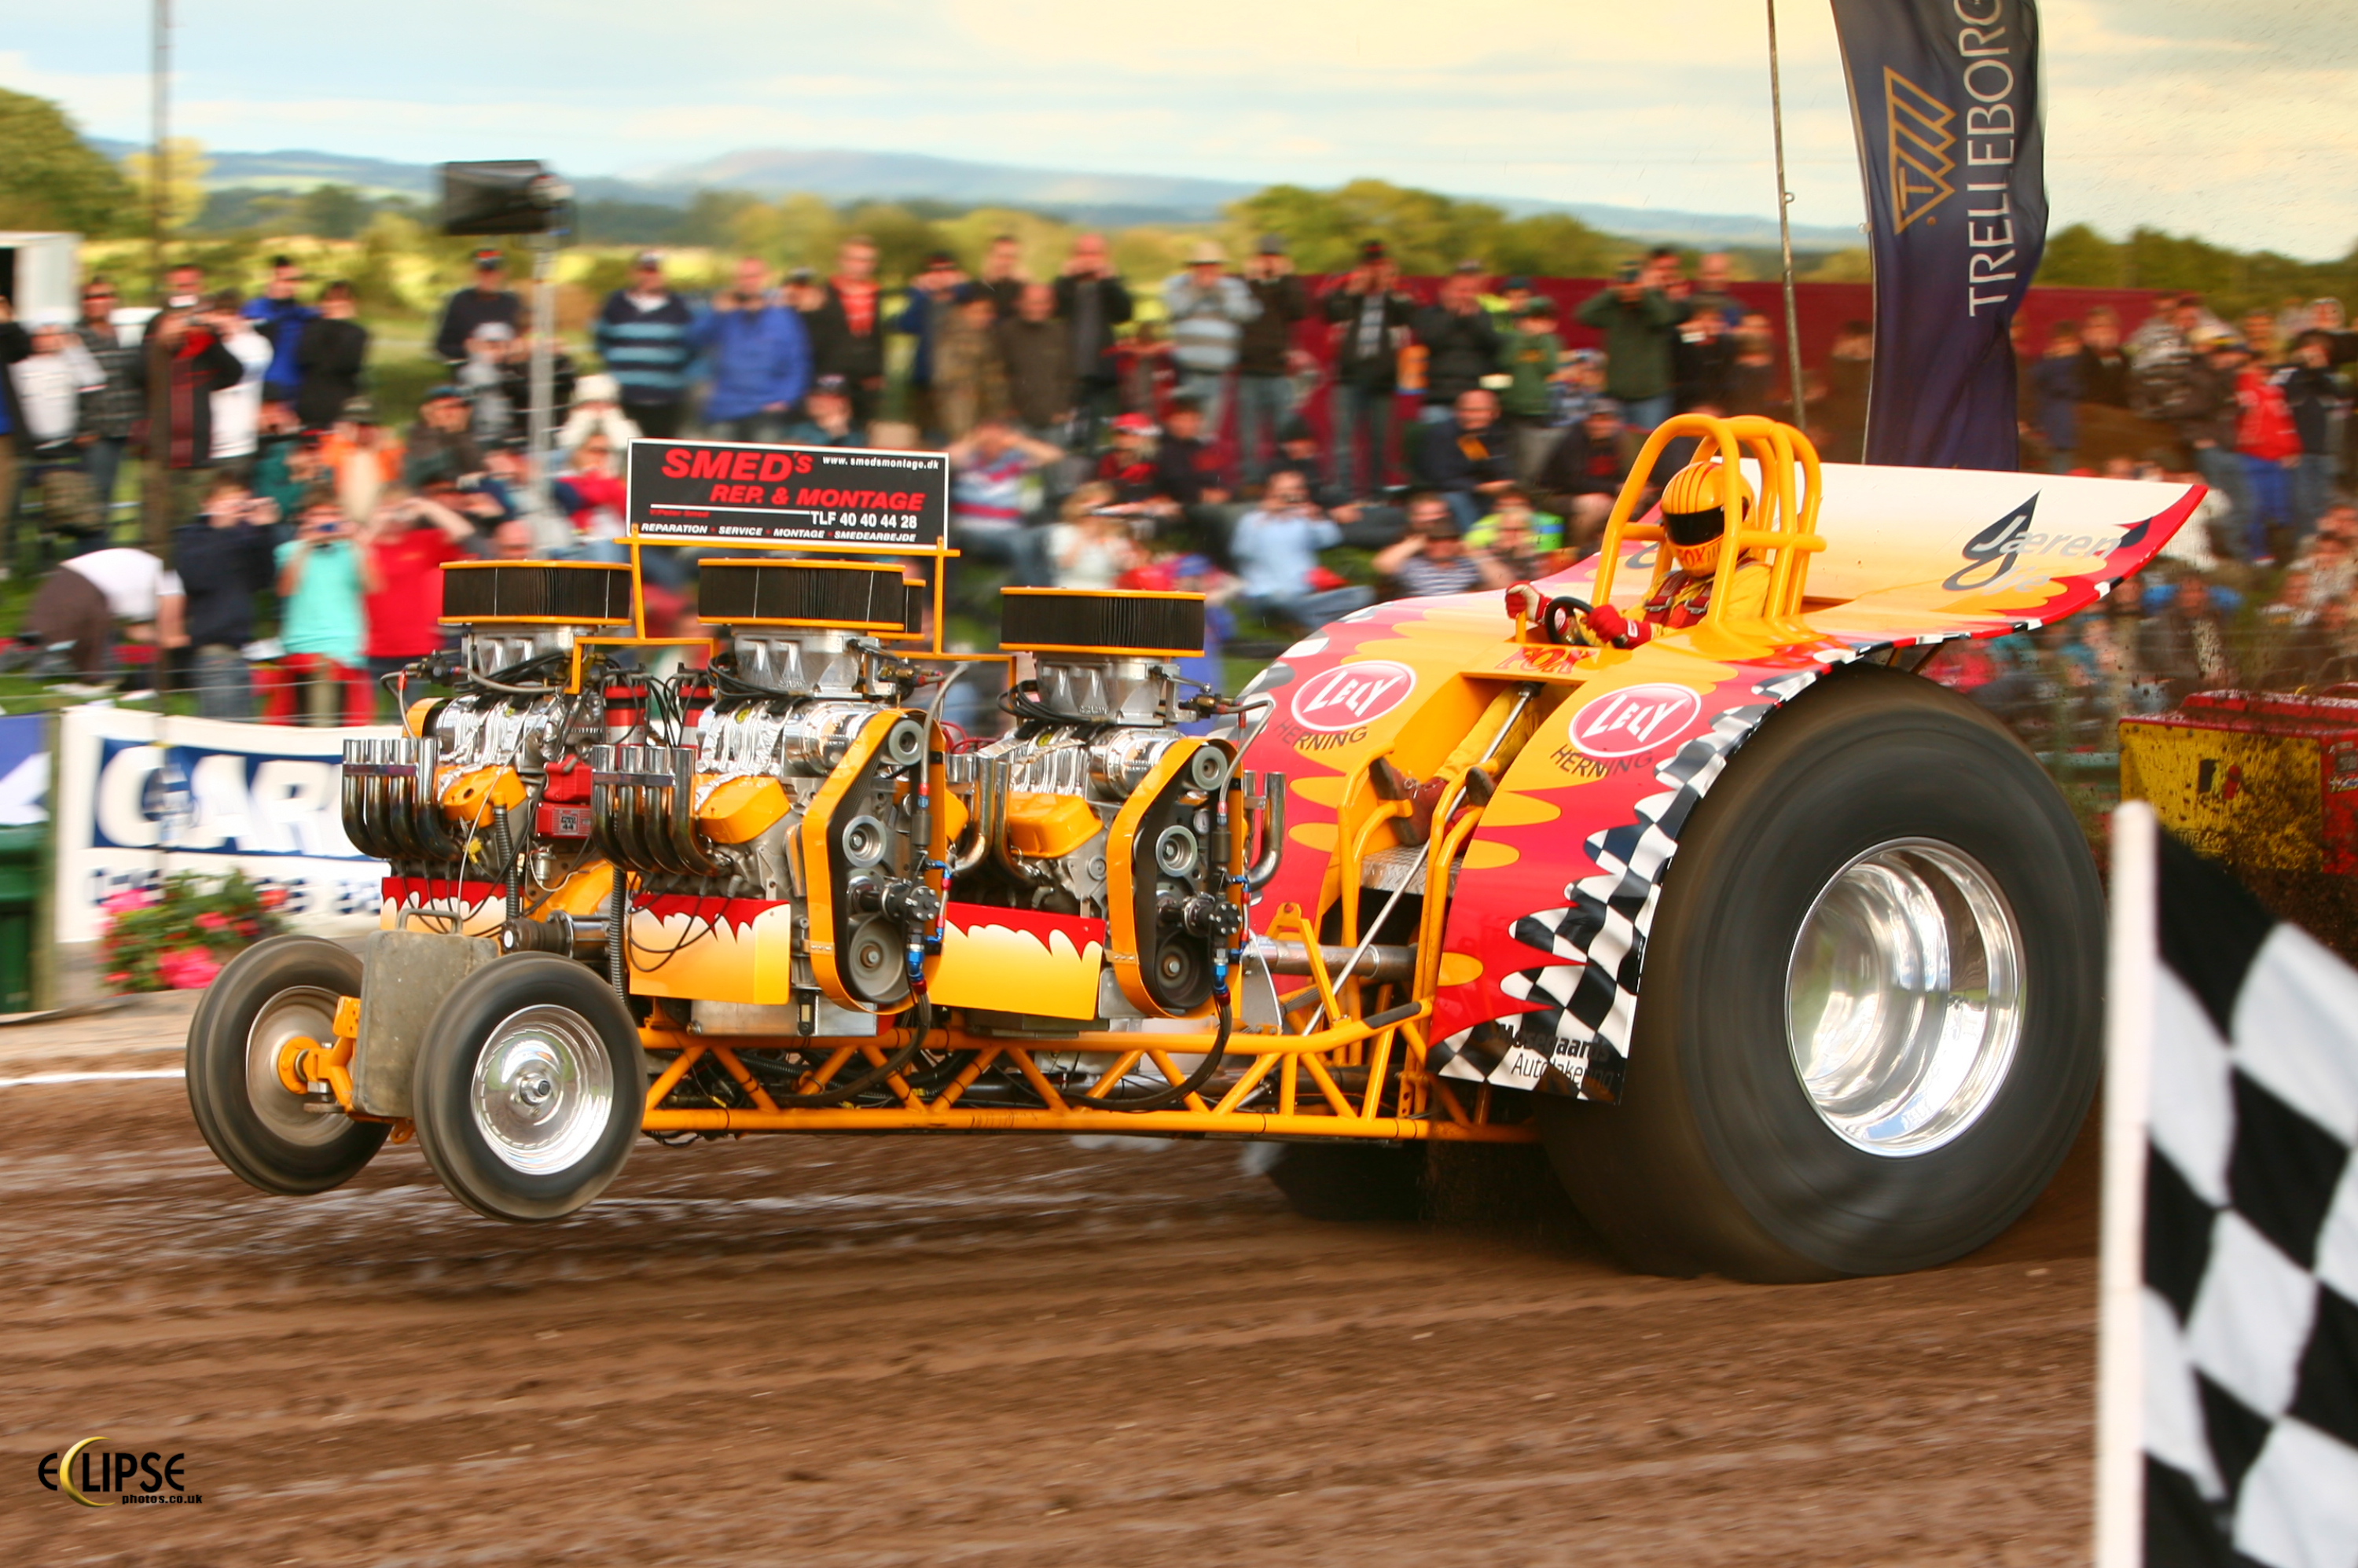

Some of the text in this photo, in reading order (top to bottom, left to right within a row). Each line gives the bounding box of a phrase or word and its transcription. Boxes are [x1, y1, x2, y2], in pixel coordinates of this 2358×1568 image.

[709, 483, 927, 512] REP. & MONTAGE
[641, 522, 916, 542] REPARATION SERVICE MONTAGE SMEDEARBEJDE
[810, 510, 918, 530] TLF 40 40 44 28
[1494, 646, 1598, 674] FOX
[1302, 670, 1405, 718] LELY
[1581, 693, 1689, 743] LELY
[1273, 718, 1368, 751] HERNING
[1550, 744, 1653, 778] HERNING
